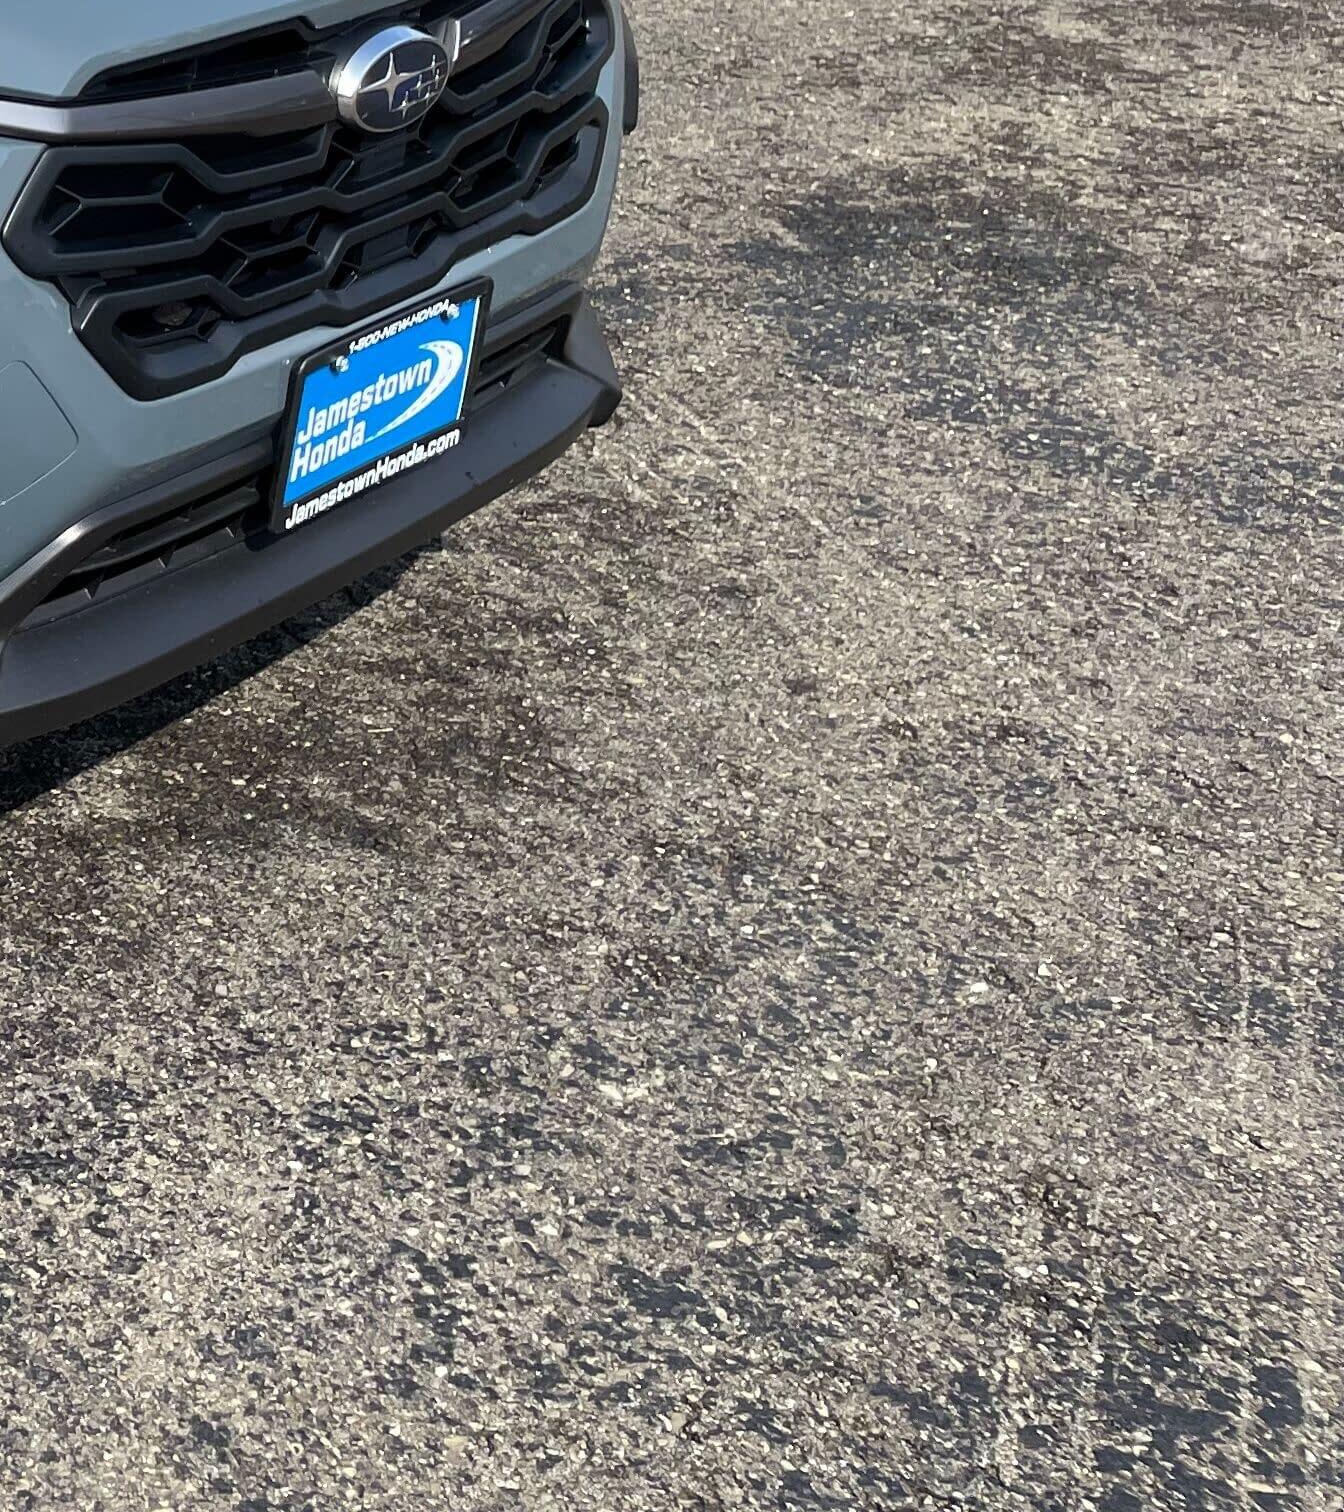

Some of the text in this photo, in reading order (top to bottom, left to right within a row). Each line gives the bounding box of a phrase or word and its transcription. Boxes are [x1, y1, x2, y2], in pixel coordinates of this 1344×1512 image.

[297, 358, 433, 445] Jamestown
[284, 428, 461, 530] JamestownHonda.com
[290, 419, 367, 483] Honda
